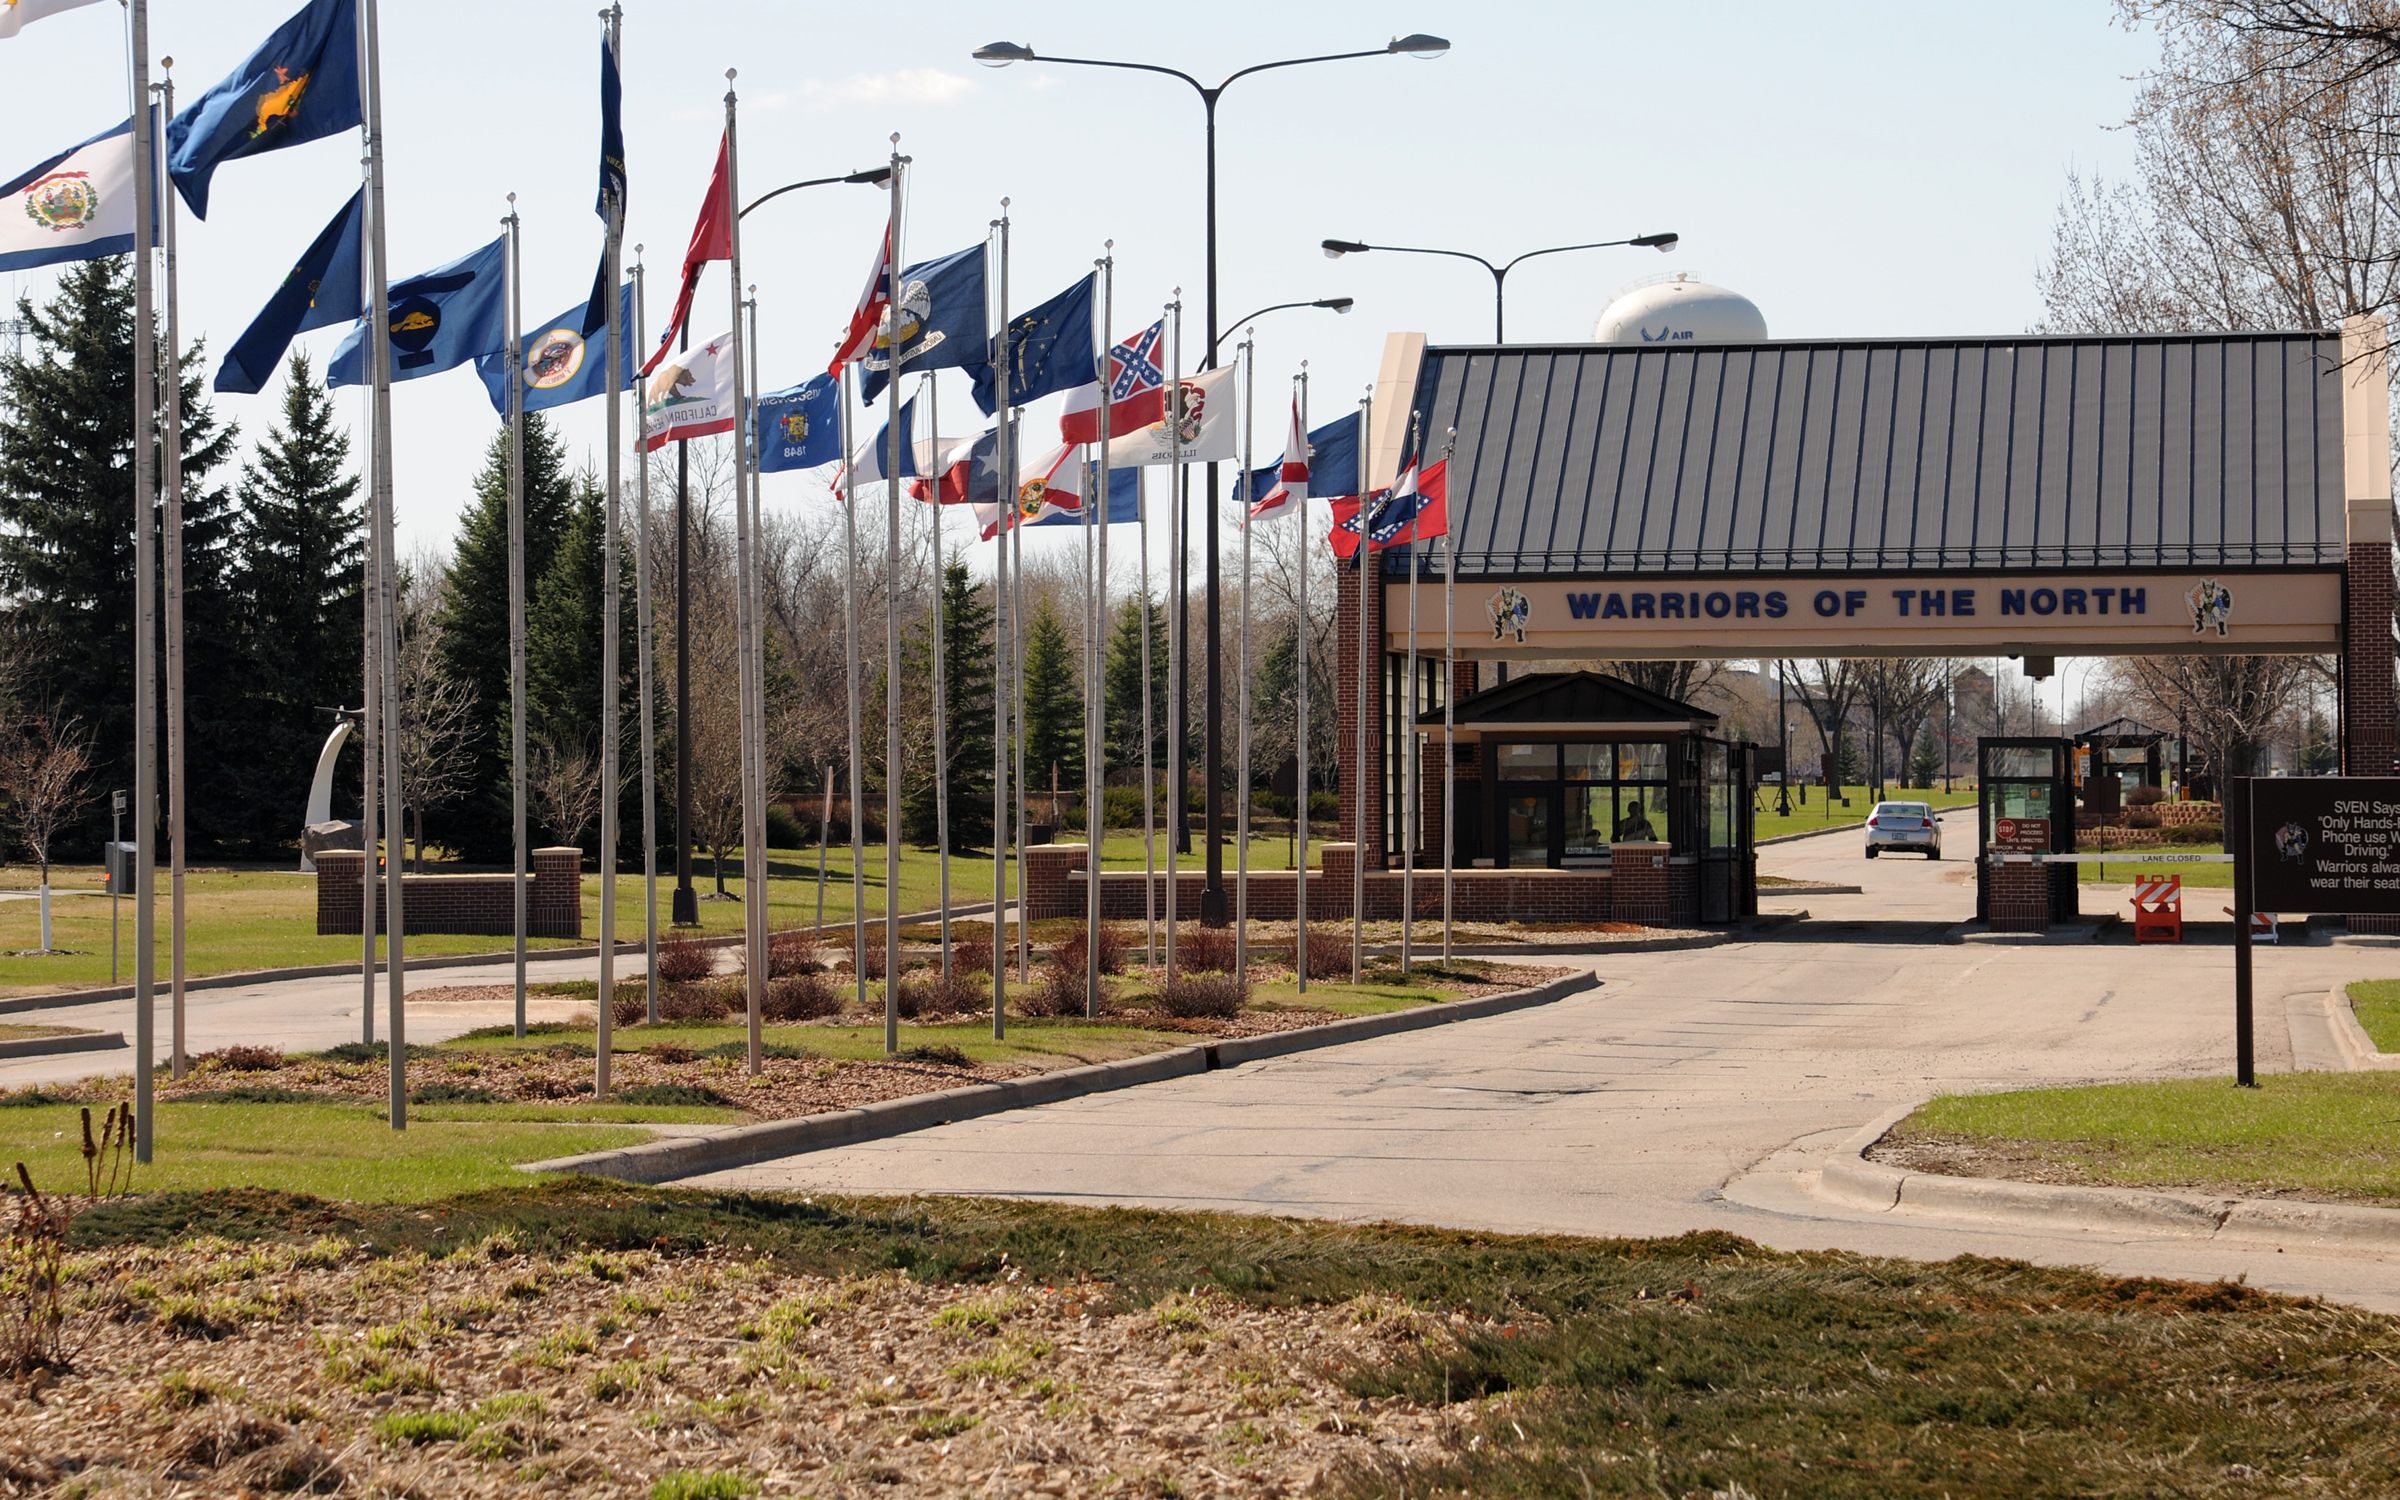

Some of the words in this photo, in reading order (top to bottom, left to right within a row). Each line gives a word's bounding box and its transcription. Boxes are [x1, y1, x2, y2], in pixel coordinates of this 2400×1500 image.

[1671, 331, 1694, 340] AIR
[1567, 592, 1788, 619] WARRIORS
[1814, 591, 1867, 617] OF
[1893, 589, 1975, 617] THE
[2001, 588, 2146, 615] NORTH
[2334, 801, 2369, 813] SVEN
[2318, 815, 2350, 831] "Only
[2322, 830, 2360, 843] Phone
[2364, 833, 2387, 843] use
[2344, 844, 2393, 860] Driving."
[2316, 860, 2368, 873] Warriors
[2371, 860, 2400, 874] alwa
[2310, 878, 2341, 888] wear
[2343, 876, 2370, 889] their
